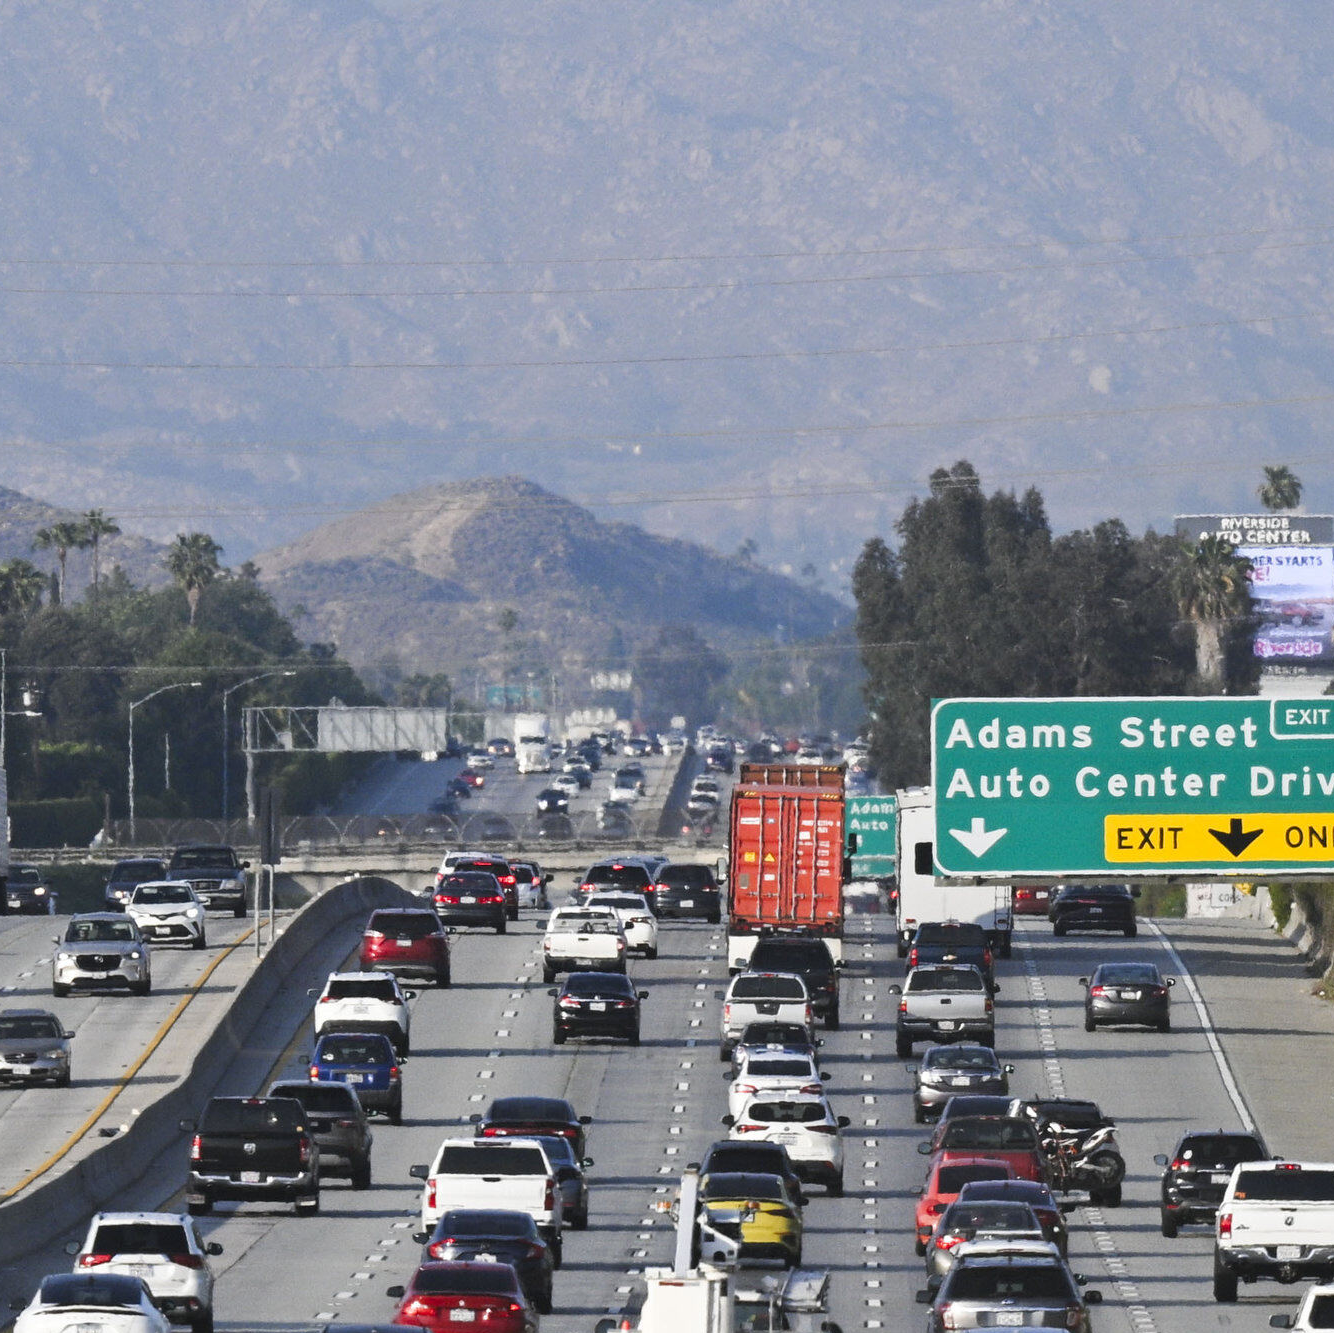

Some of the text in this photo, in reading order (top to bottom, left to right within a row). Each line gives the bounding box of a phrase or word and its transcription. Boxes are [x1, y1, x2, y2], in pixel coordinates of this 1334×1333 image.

[1220, 516, 1290, 530] RIVERSIDE
[1245, 530, 1311, 544] CENTER
[1275, 555, 1323, 567] STARTS
[1285, 708, 1331, 726] EXIT
[944, 716, 1258, 749] Adams Street
[945, 767, 1050, 799] Auto
[1075, 766, 1226, 798] Center
[850, 801, 894, 815] Adam
[850, 818, 889, 831] Auto
[1116, 827, 1184, 850] EXIT
